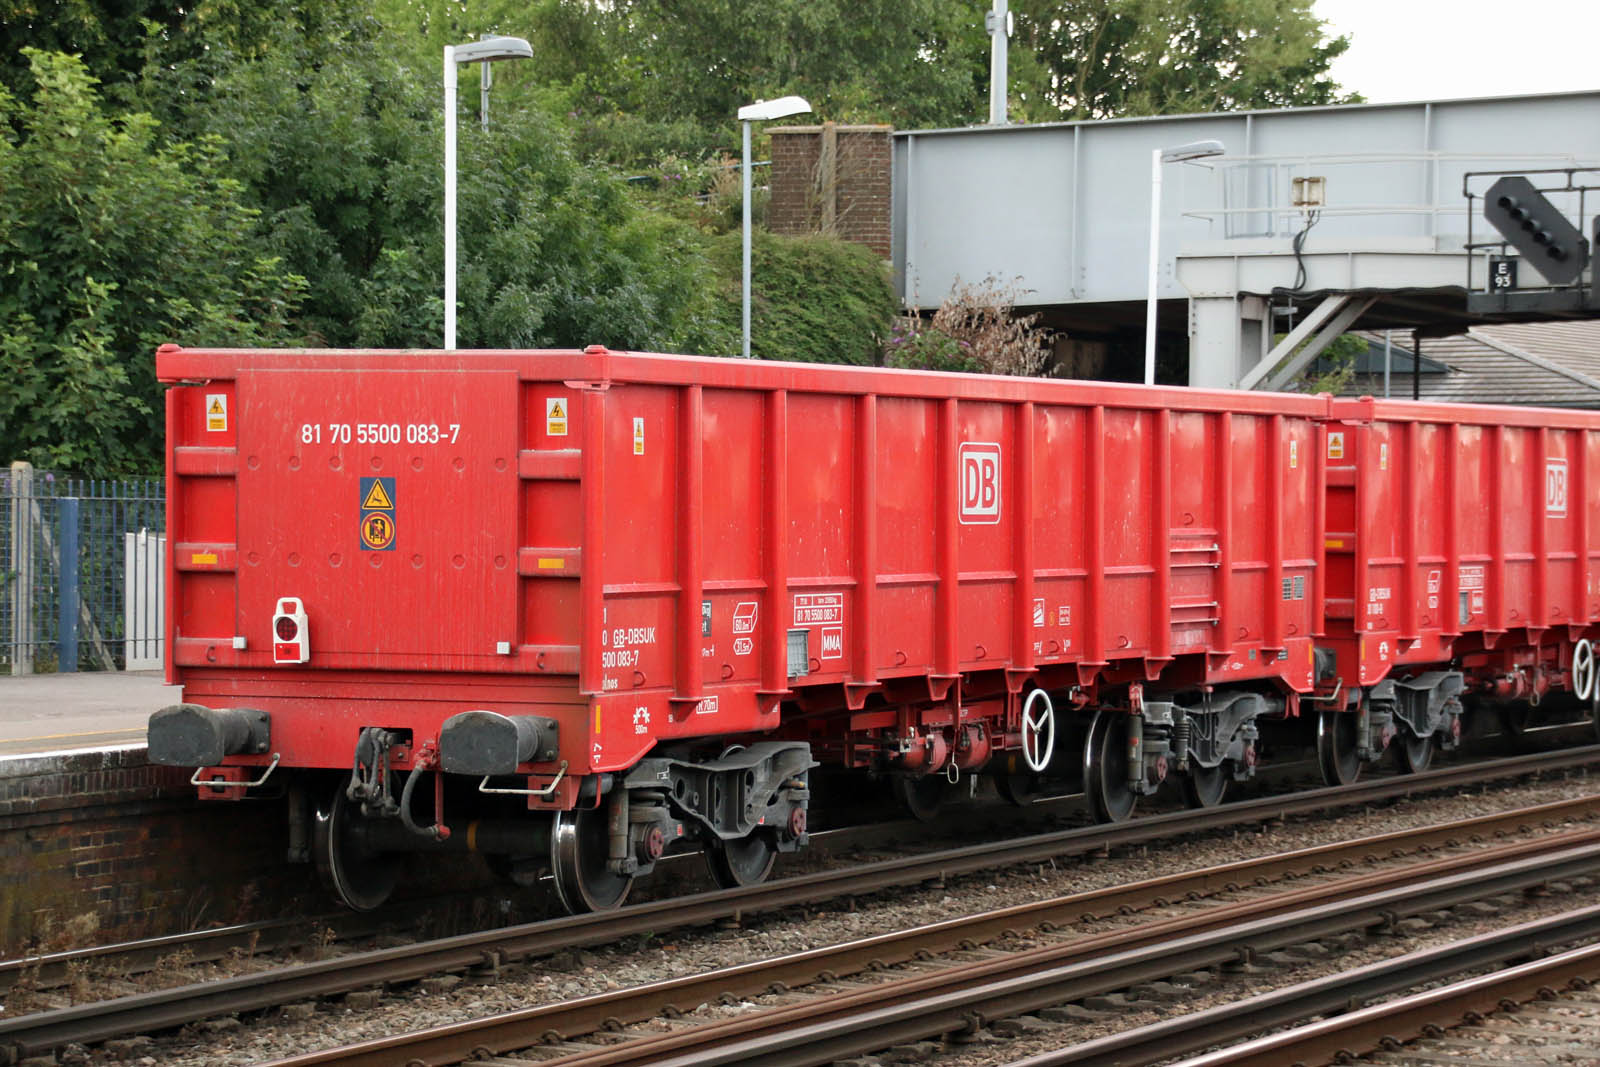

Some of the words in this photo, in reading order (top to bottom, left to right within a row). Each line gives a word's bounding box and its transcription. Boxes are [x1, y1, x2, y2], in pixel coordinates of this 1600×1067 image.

[1498, 263, 1508, 274] E
[1495, 276, 1511, 287] 93
[301, 424, 321, 444] 81
[329, 424, 351, 444] 70
[357, 424, 400, 444] 5500
[406, 424, 460, 444] 083-7
[965, 458, 996, 508] DB
[1549, 470, 1564, 507] DB
[602, 629, 608, 646] 0
[613, 627, 656, 648] GB-DBSUK
[823, 635, 841, 651] MMA
[602, 651, 616, 668] 500
[617, 649, 639, 667] 083-7
